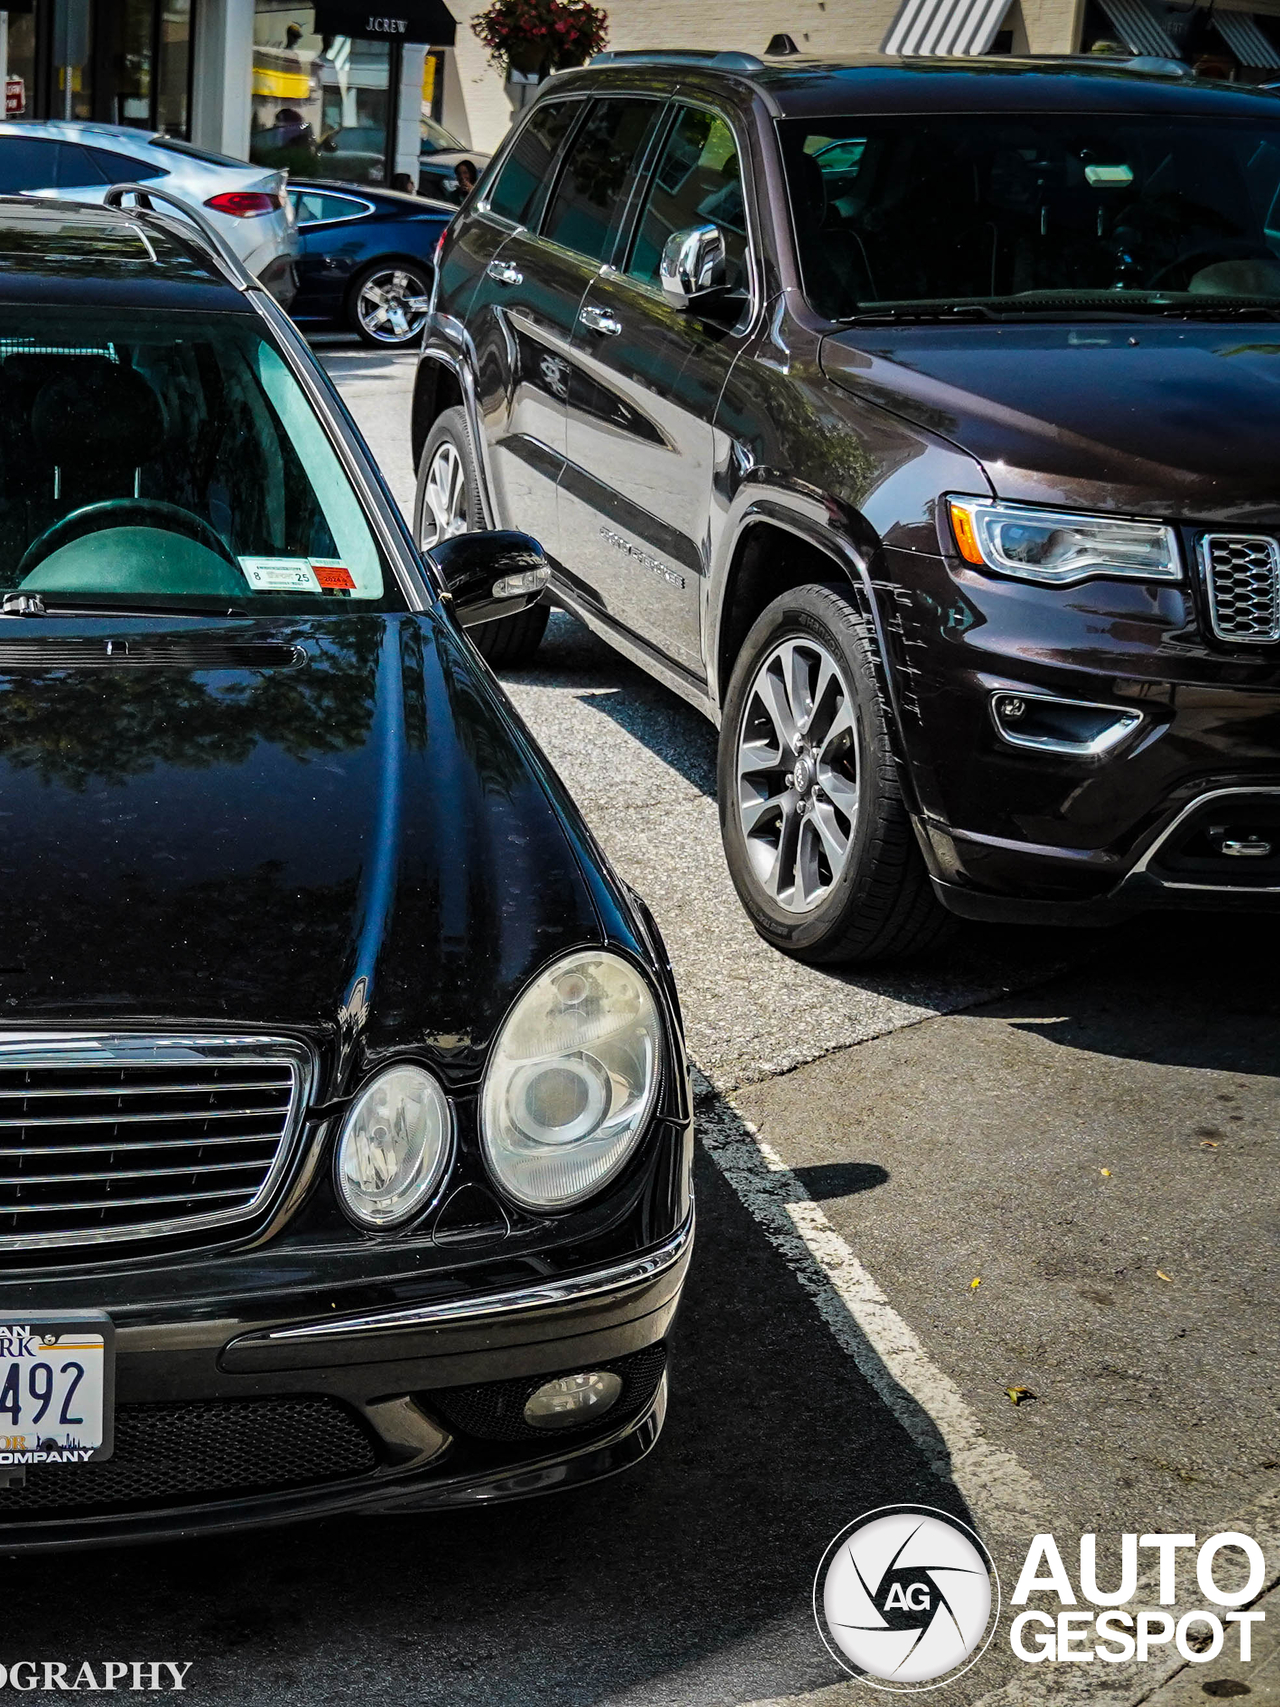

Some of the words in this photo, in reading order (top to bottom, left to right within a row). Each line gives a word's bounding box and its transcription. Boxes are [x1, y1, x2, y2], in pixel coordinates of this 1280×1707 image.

[365, 17, 408, 33] J.CREW
[253, 571, 261, 581] 8
[295, 573, 310, 582] 25
